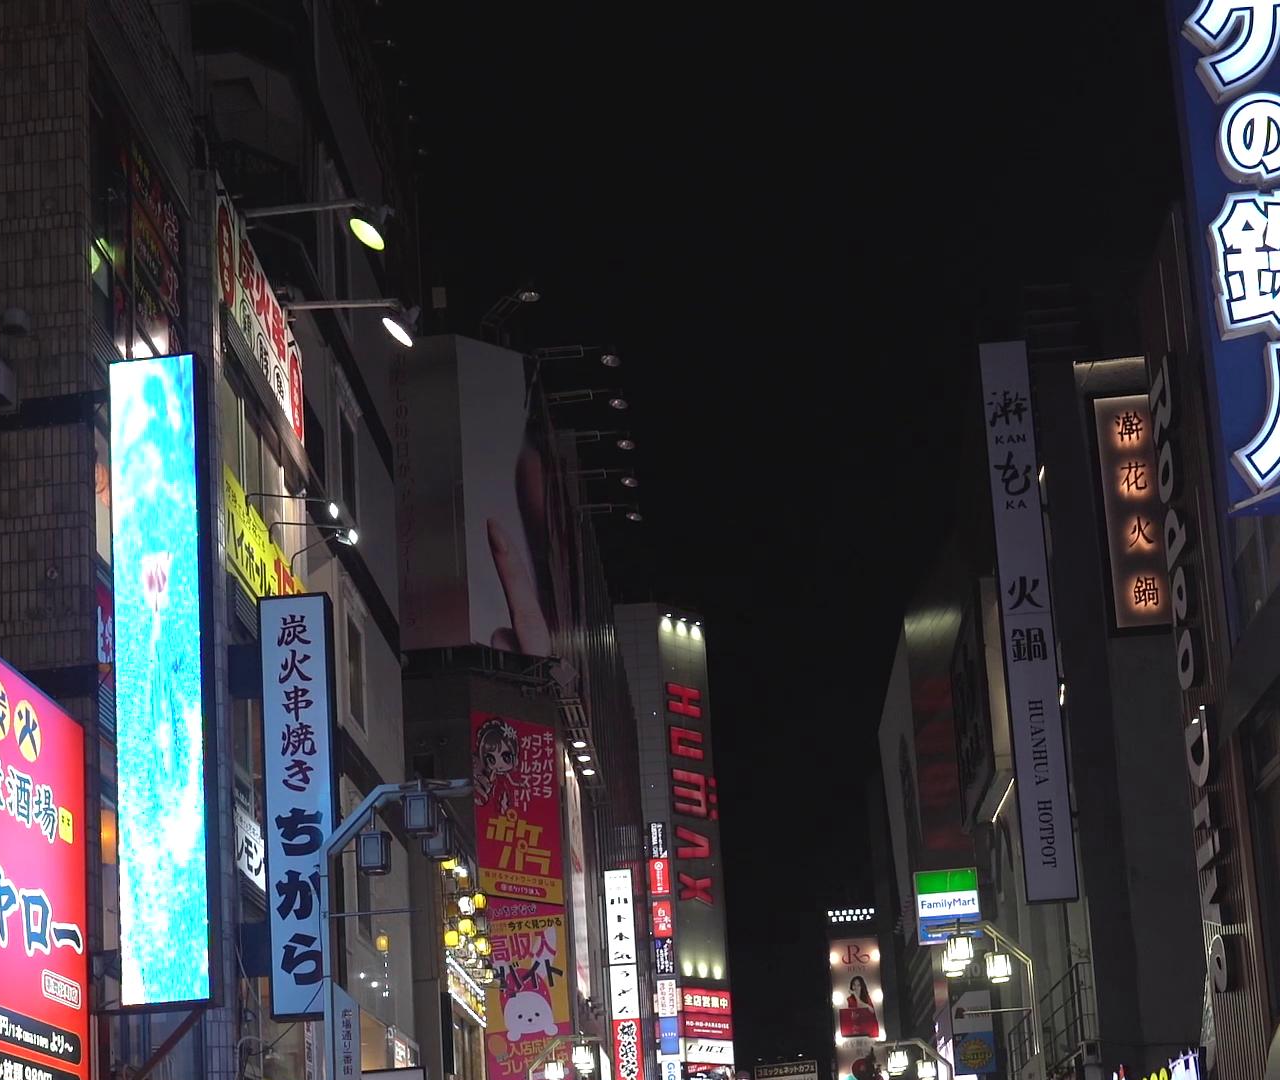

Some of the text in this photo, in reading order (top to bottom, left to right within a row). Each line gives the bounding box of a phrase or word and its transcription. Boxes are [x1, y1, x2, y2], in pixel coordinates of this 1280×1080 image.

[995, 433, 1026, 445] KAN
[1005, 500, 1028, 510] KA
[1008, 575, 1049, 663] 火鍋
[277, 613, 318, 793] 炭火串焼き
[520, 735, 532, 813] ガールズバー
[531, 733, 543, 797] コンカフェ
[541, 731, 554, 799] キャバクラ
[1027, 699, 1058, 869] HUANHUA HOTPOT
[486, 809, 545, 848] ポケ
[498, 839, 552, 876] パラ
[274, 807, 324, 987] ちから
[921, 897, 976, 910] FamilyMart
[489, 930, 557, 964] 高収入
